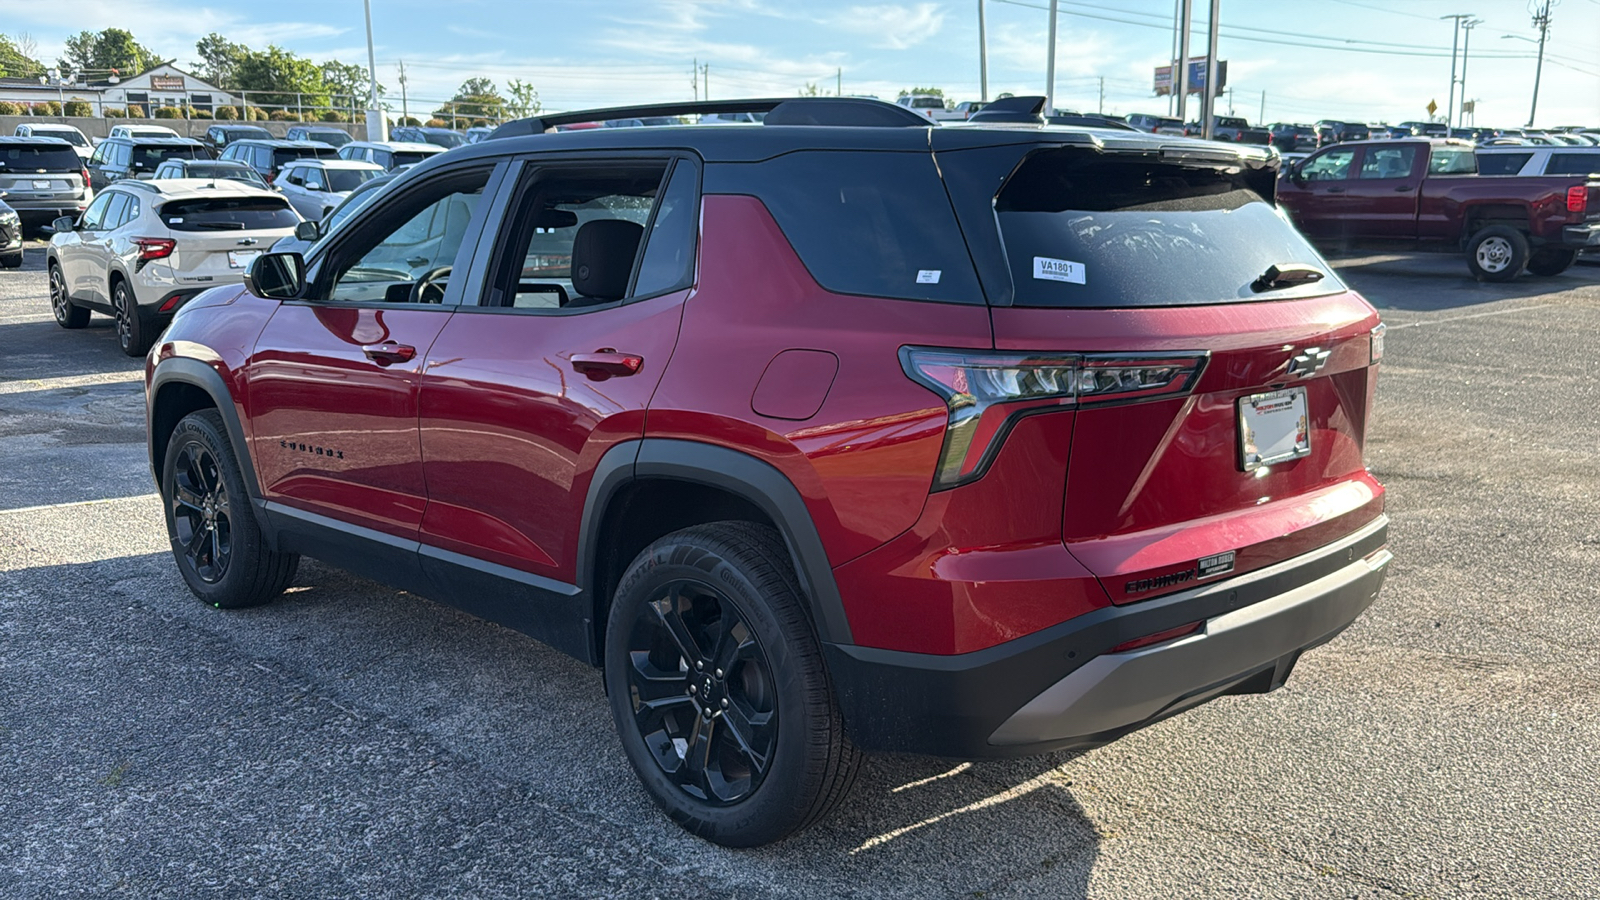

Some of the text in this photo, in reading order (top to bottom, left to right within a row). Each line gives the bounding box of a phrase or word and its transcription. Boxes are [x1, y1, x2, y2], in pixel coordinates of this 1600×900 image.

[1041, 260, 1073, 273] VA1801
[280, 440, 344, 459] EQUINOX
[1126, 568, 1196, 594] EQUINOX
